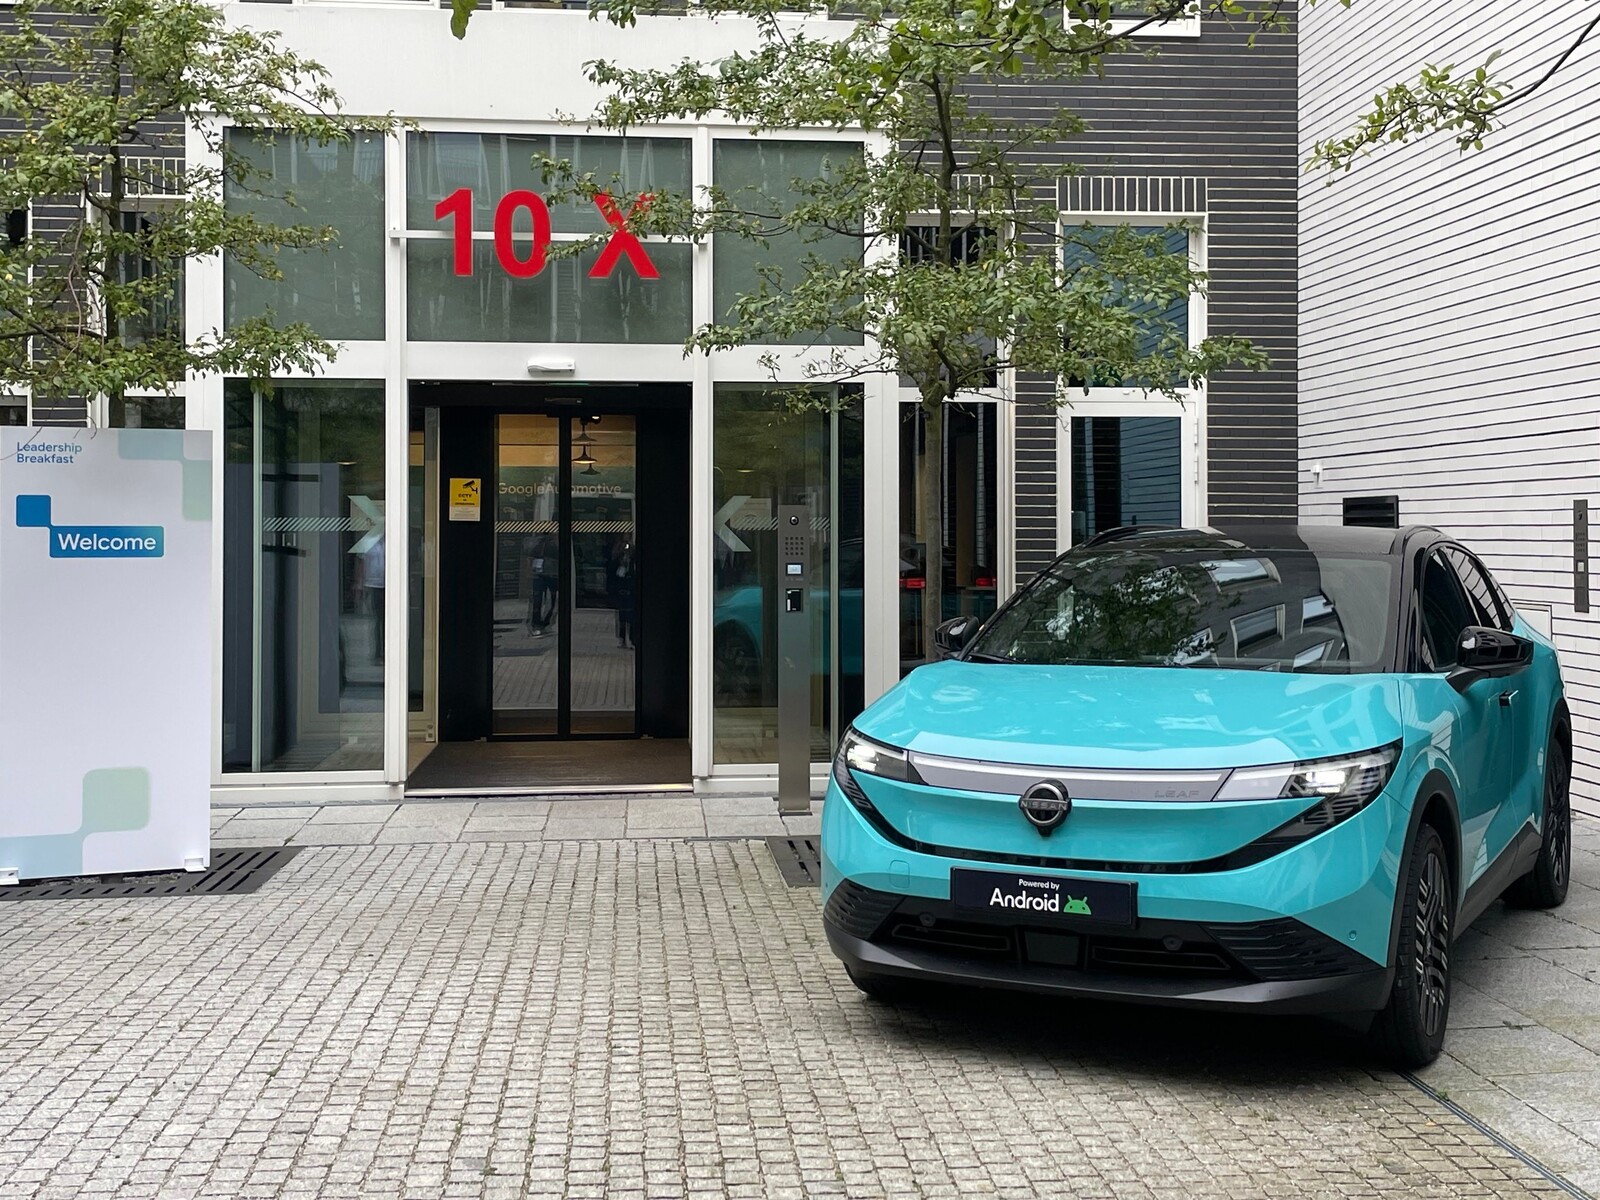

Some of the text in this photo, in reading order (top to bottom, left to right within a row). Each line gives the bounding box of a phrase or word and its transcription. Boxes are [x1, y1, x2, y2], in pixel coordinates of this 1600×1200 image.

[434, 187, 661, 279] 10 X
[16, 441, 82, 454] Leadership
[16, 453, 74, 464] Breakfast
[498, 482, 622, 496] GoogleAuomotive
[58, 533, 157, 551] Welcome
[1154, 789, 1200, 799] LEAF
[1020, 800, 1067, 811] NISSAN
[1018, 878, 1060, 891] Powered by
[989, 887, 1060, 912] Android
